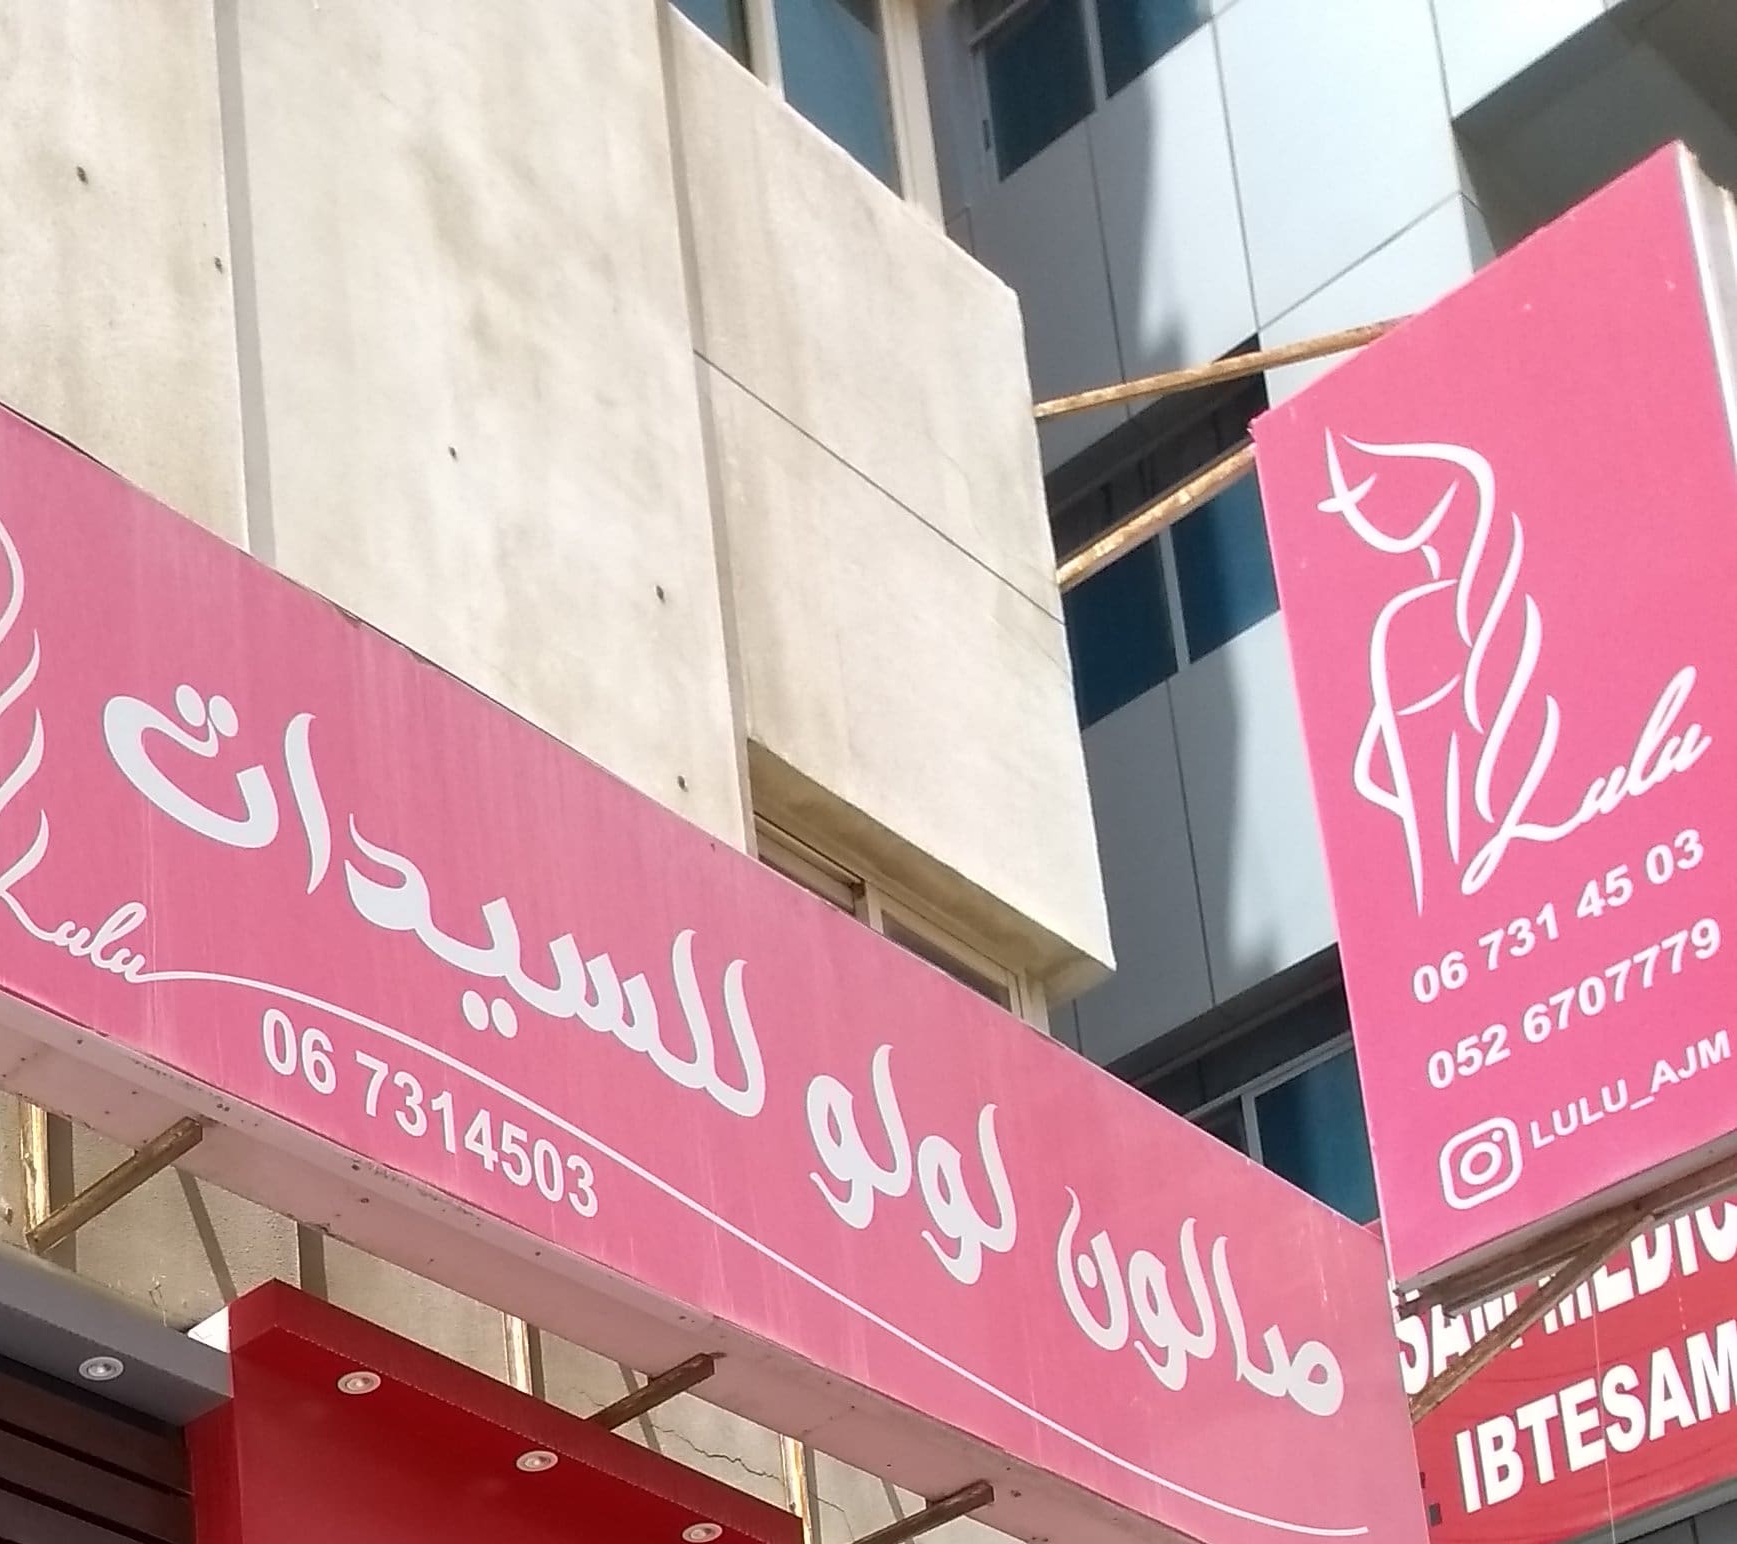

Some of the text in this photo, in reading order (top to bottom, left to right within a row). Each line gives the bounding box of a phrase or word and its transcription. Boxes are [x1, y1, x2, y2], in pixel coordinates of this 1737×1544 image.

[1461, 665, 1713, 895] Lulu
[1414, 828, 1704, 1004] 06 731 45 03
[1427, 917, 1722, 1090] 052 6707779
[104, 683, 1344, 1416] صالون لولو للسيدات
[263, 1008, 598, 1218] 06 7314503
[1530, 1029, 1733, 1150] LULU_AJM
